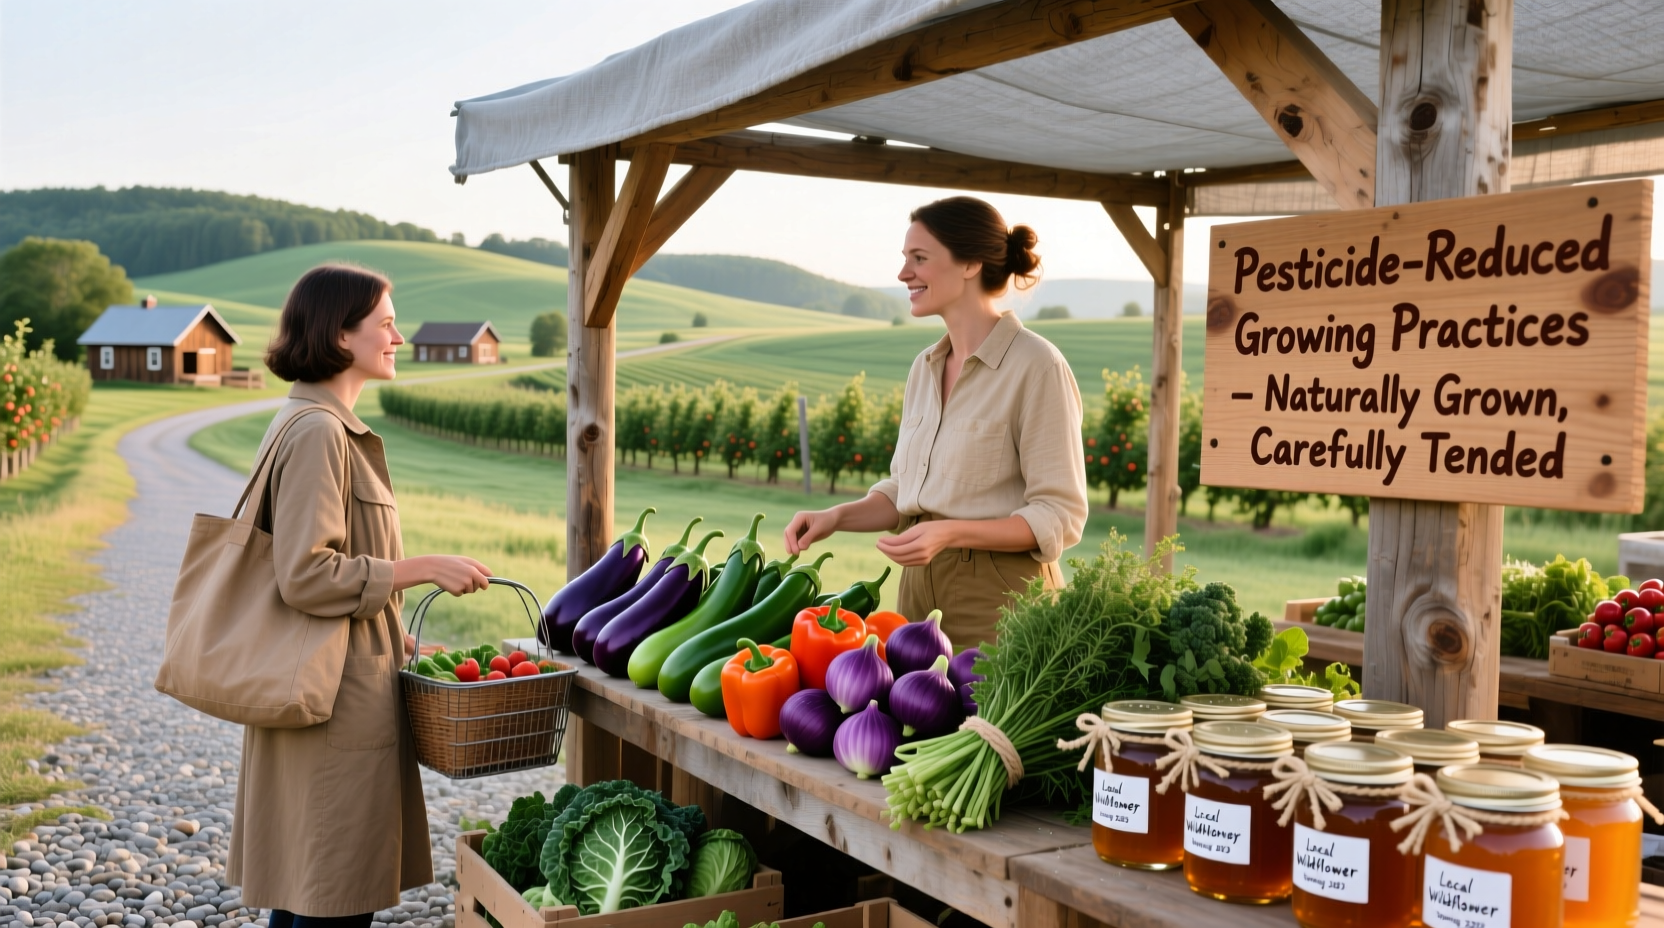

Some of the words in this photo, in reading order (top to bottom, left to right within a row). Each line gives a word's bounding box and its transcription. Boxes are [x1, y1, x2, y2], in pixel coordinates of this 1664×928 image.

[1234, 213, 1613, 294] Pesticide-Reduced
[1234, 311, 1376, 369] Growing
[1391, 302, 1589, 352] Practices
[1264, 373, 1421, 430] Naturally
[1433, 373, 1568, 423] Grown,
[1250, 426, 1407, 486] Carefully
[1420, 430, 1567, 479] Tended
[1296, 850, 1358, 878] Wildflower
[1439, 870, 1474, 894] Local
